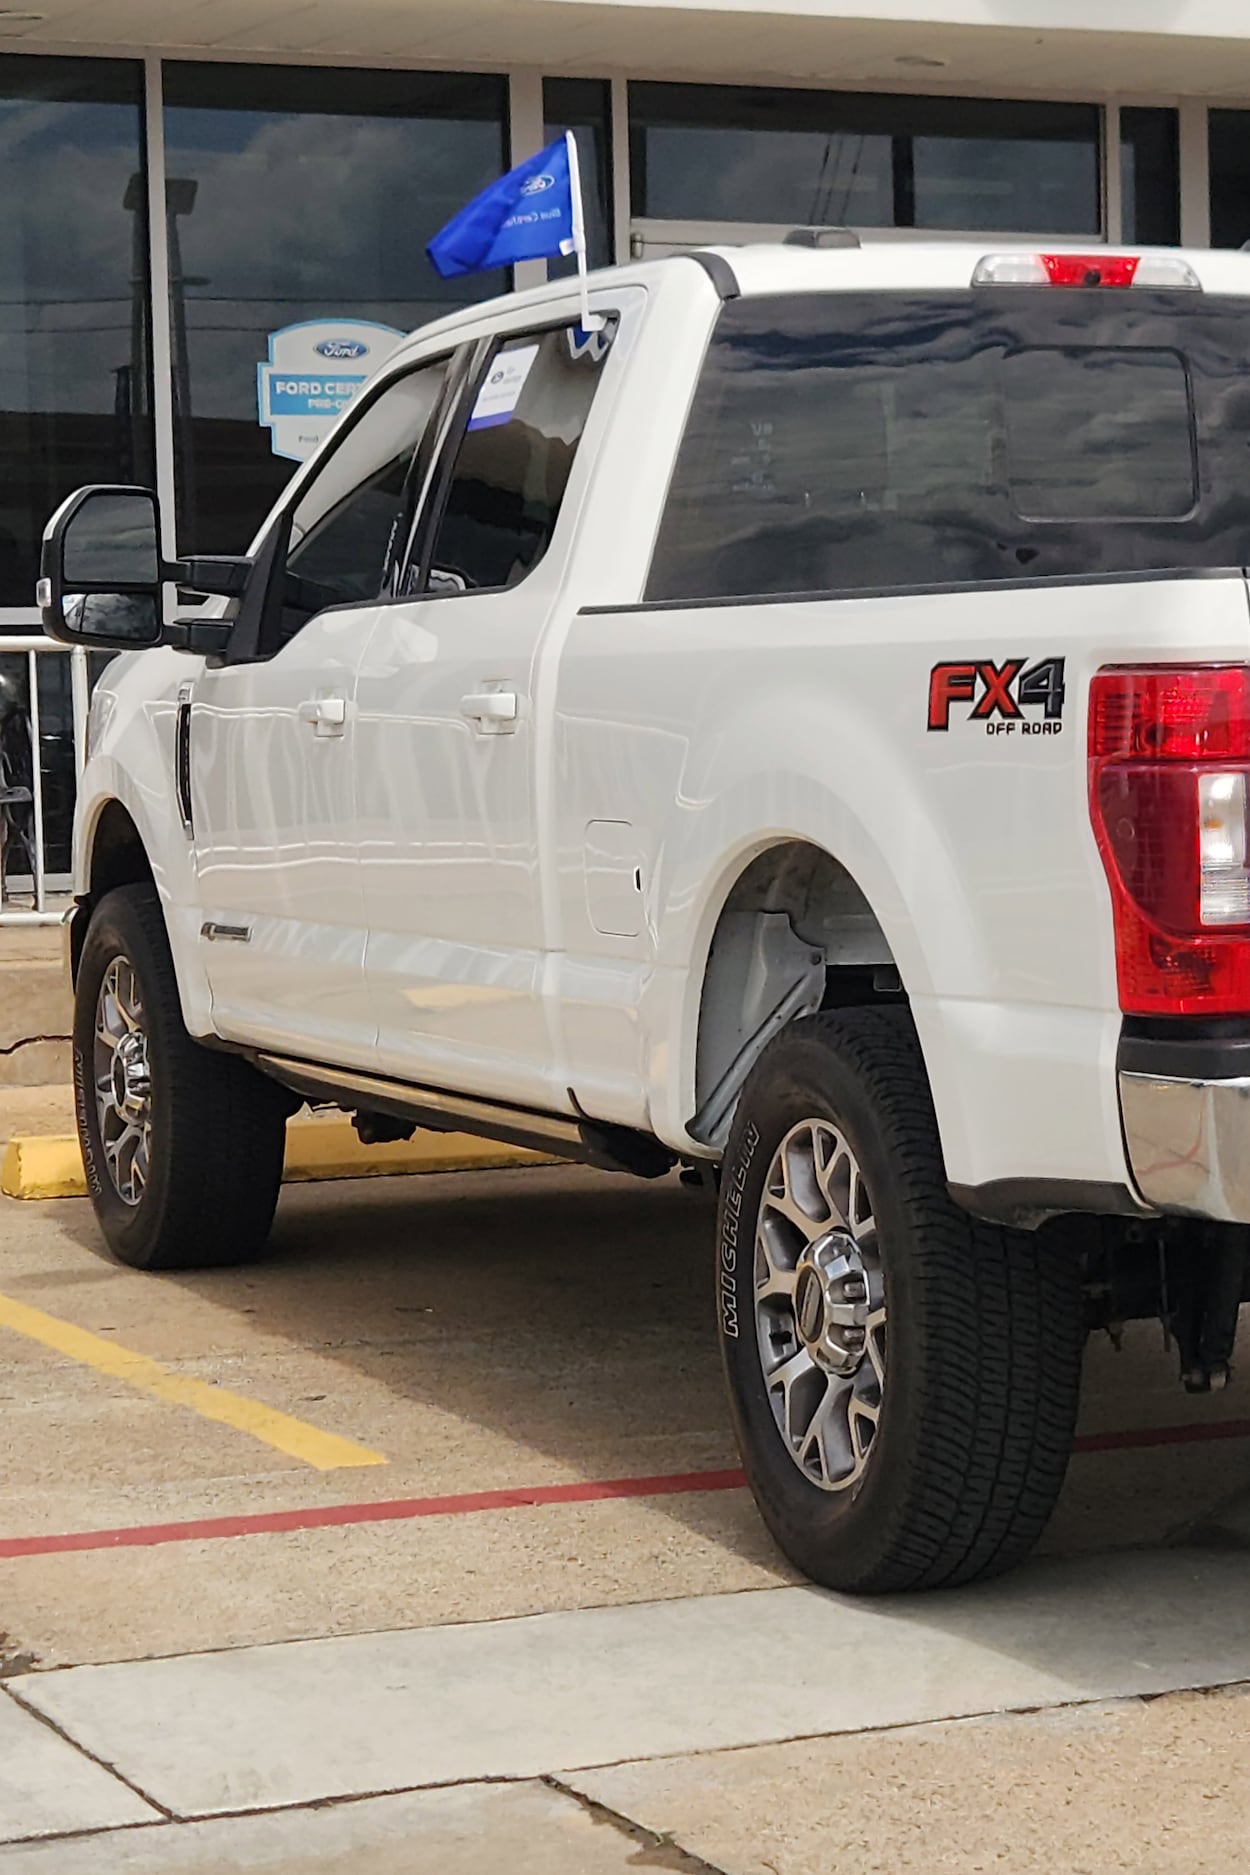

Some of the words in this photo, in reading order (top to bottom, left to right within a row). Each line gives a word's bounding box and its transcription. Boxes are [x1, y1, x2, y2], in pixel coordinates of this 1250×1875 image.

[323, 341, 360, 357] Ford
[275, 381, 322, 395] FORD
[927, 656, 1066, 732] FX4
[987, 722, 1016, 735] OFF
[1021, 722, 1062, 735] ROAD
[720, 1121, 761, 1338] MICHELIN
